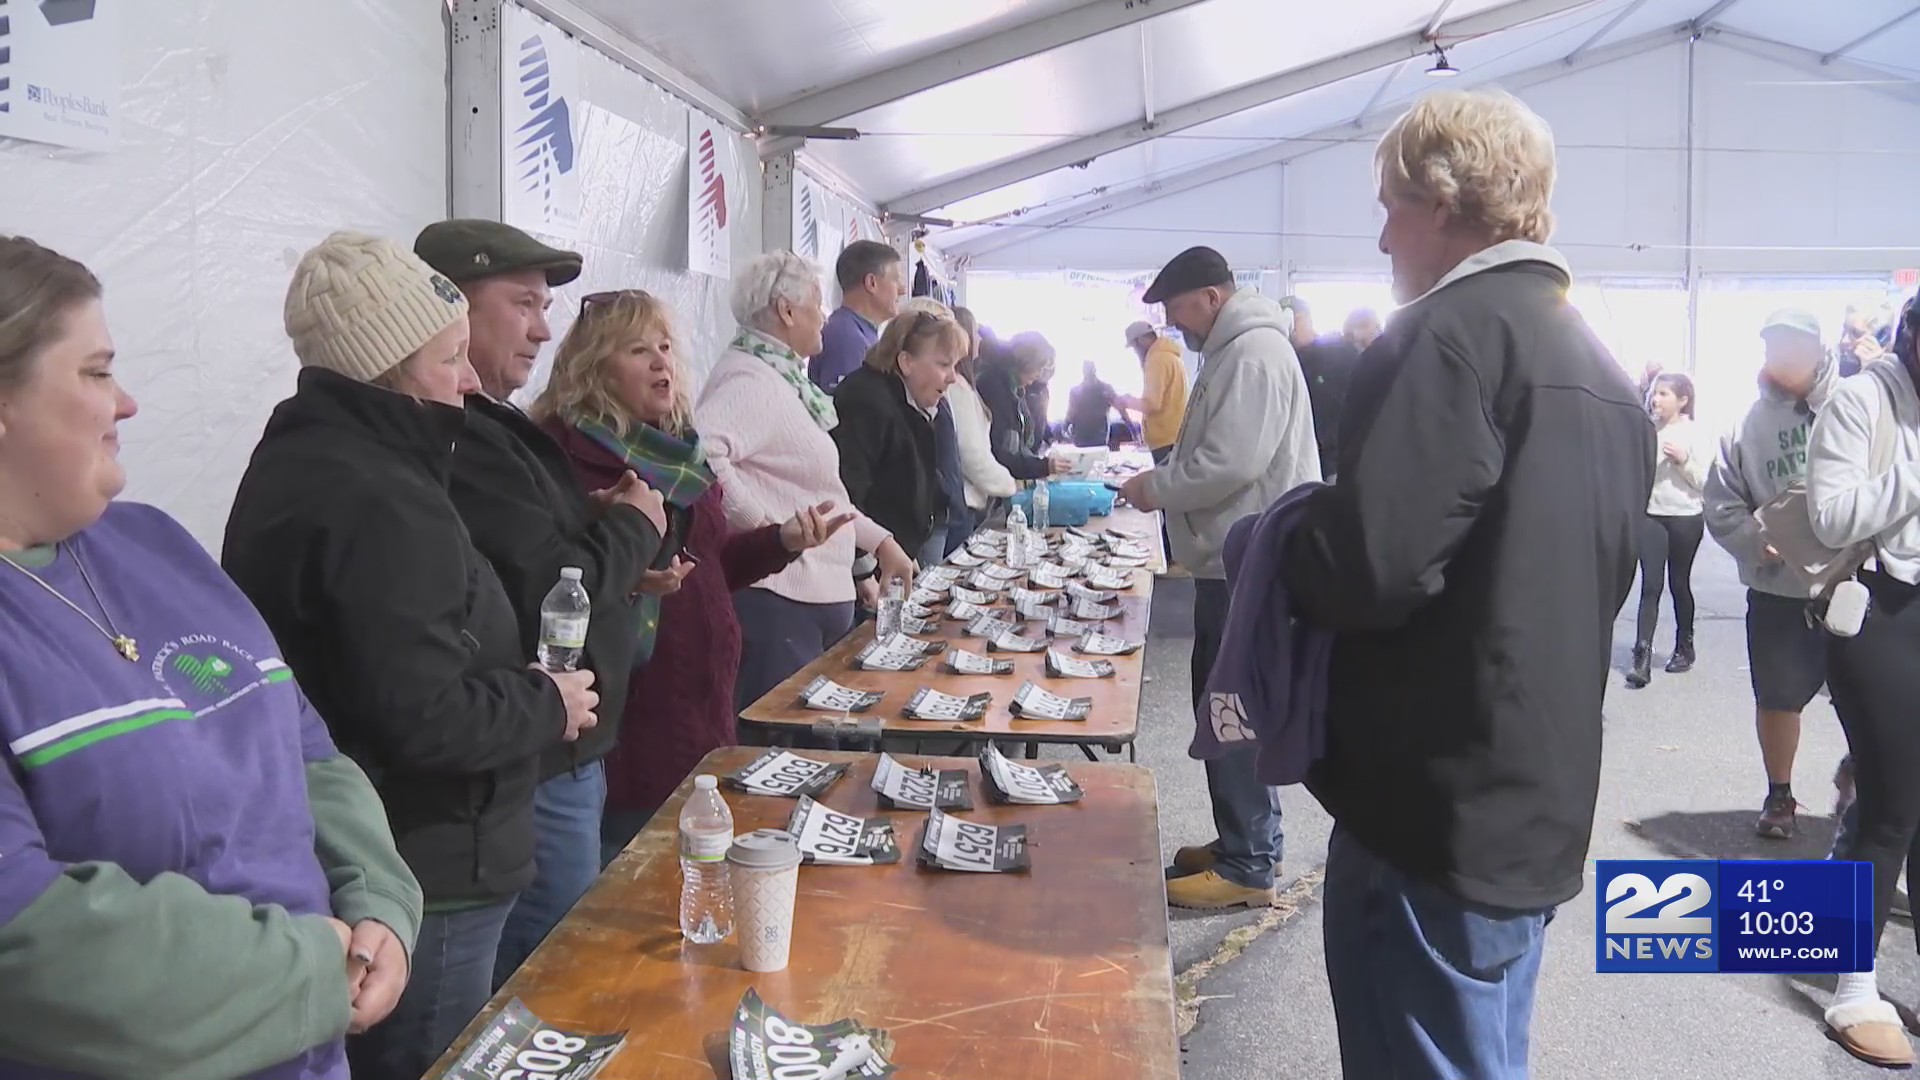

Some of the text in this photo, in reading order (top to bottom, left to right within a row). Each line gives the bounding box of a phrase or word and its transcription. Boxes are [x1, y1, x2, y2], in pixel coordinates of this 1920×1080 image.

[1778, 423, 1807, 450] SAI
[180, 634, 217, 646] ROAD
[222, 640, 254, 661] RACE
[761, 759, 823, 792] 6305
[898, 769, 937, 805] 6229
[1006, 762, 1054, 798] 6201
[814, 813, 861, 857] 6276
[953, 823, 994, 866] 6251
